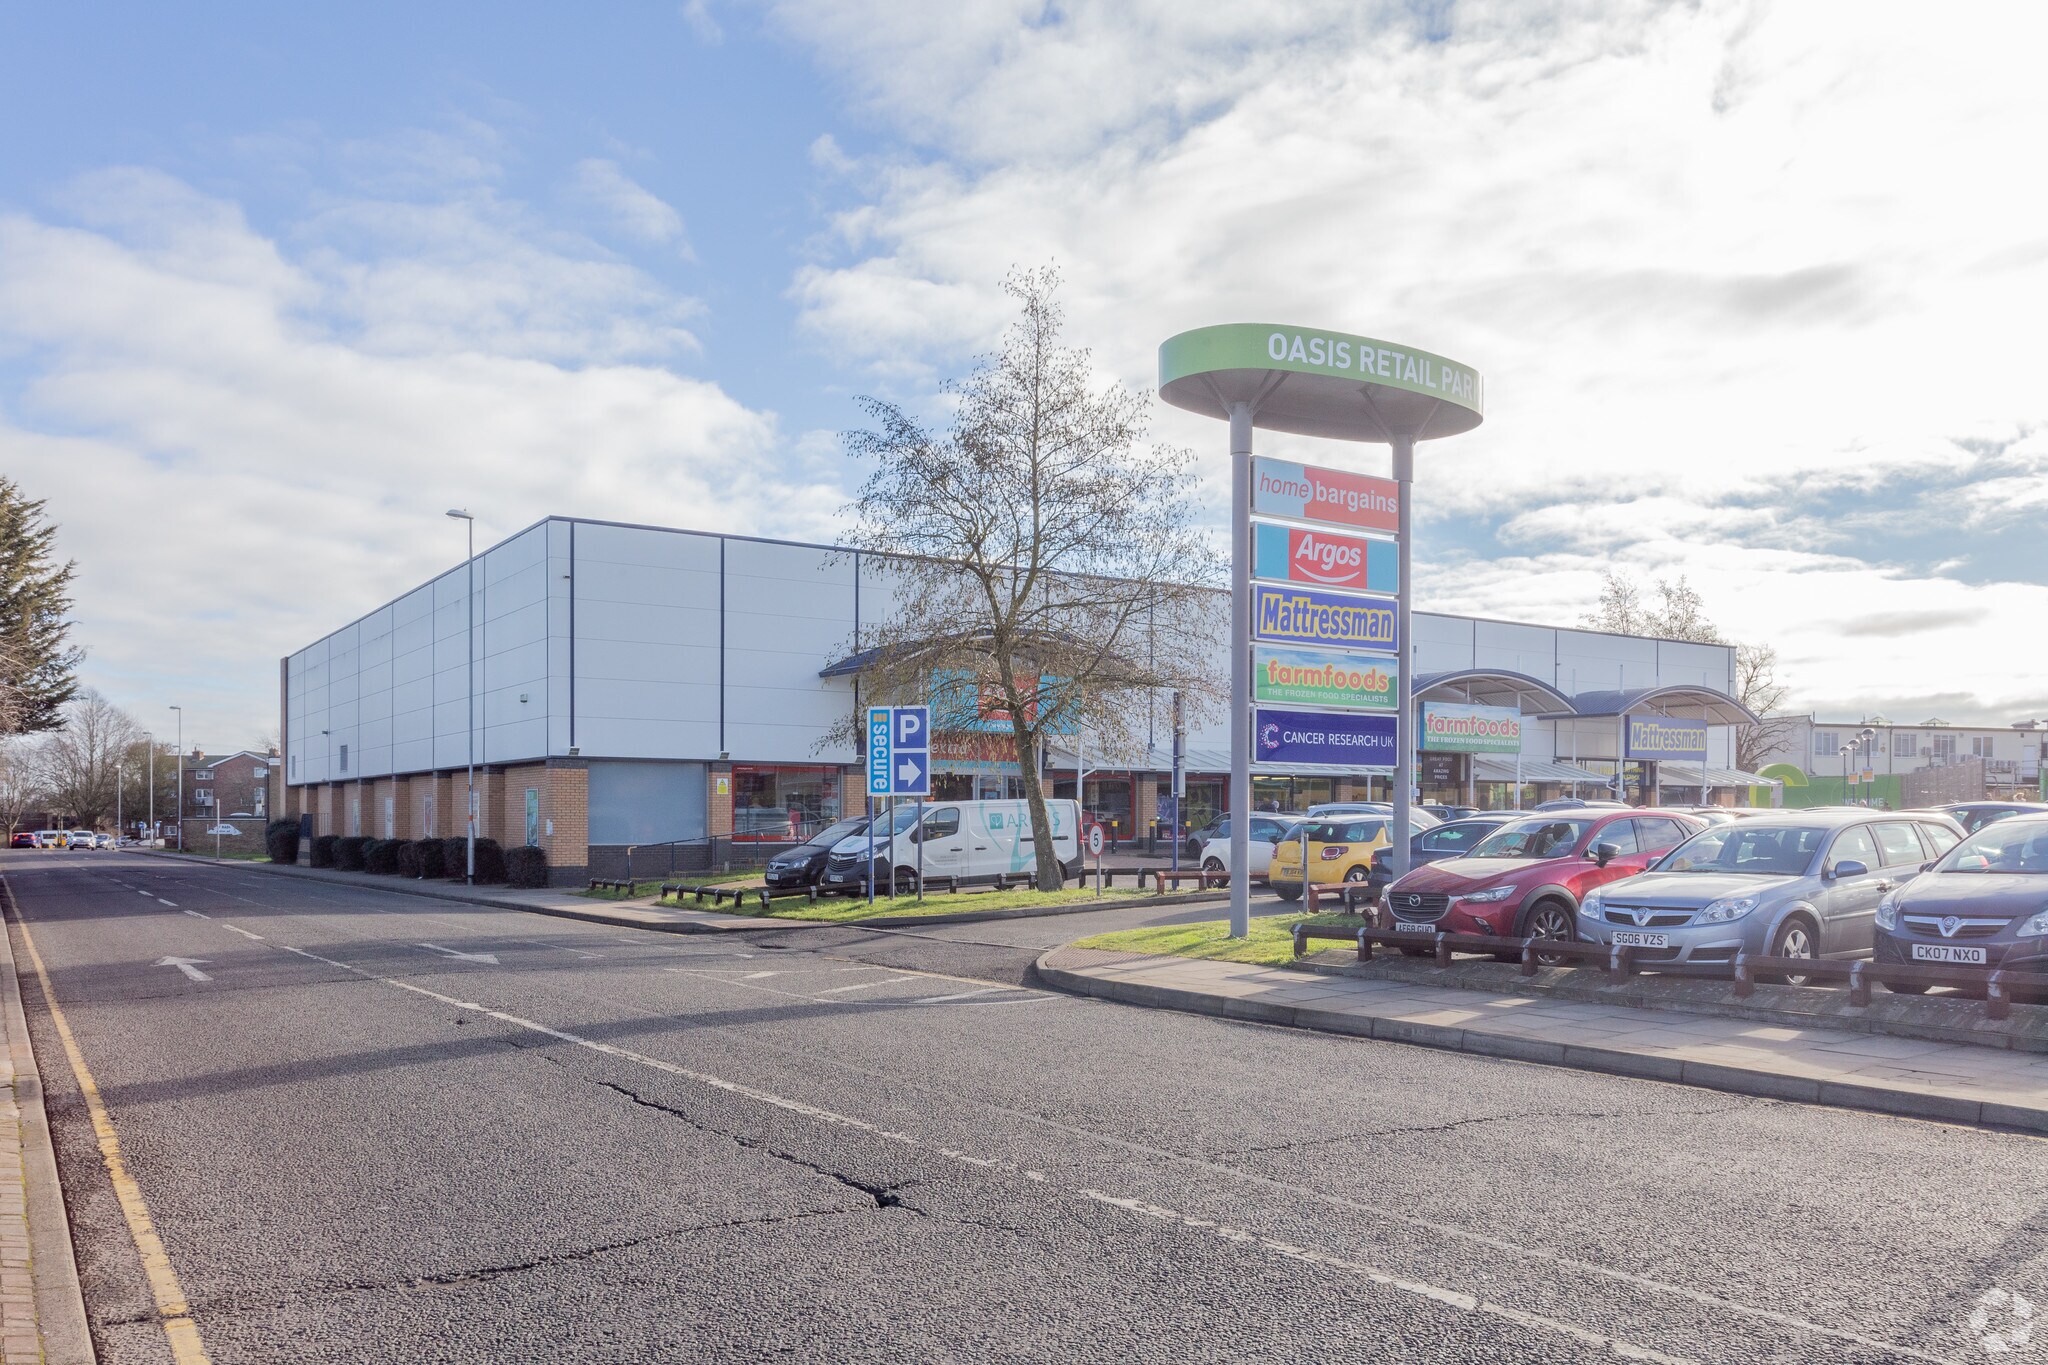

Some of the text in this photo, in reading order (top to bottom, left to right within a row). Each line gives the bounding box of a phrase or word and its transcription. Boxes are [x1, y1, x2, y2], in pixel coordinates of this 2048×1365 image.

[1268, 332, 1351, 369] OASIS
[1360, 345, 1436, 389] RETAIL
[1259, 472, 1397, 513] home bargains
[1295, 533, 1361, 571] Argos
[1260, 593, 1394, 642] Mattressman
[1267, 659, 1389, 692] farmfoods
[1268, 688, 1389, 703] THE FROZEN FOOD SPECIALISTS
[900, 714, 921, 743] P
[1426, 713, 1519, 737] farmfoods
[1631, 722, 1706, 751] Mattressman
[1283, 731, 1394, 748] CANCER RESEARCH UK
[1427, 735, 1520, 746] THE FROZEN FOOD SPECIALISTS
[873, 724, 888, 790] secure
[1006, 811, 1061, 828] ARS
[1093, 833, 1099, 847] 5
[1616, 933, 1664, 946] SG06 VZS
[1917, 946, 1980, 962] CK07 NXO
